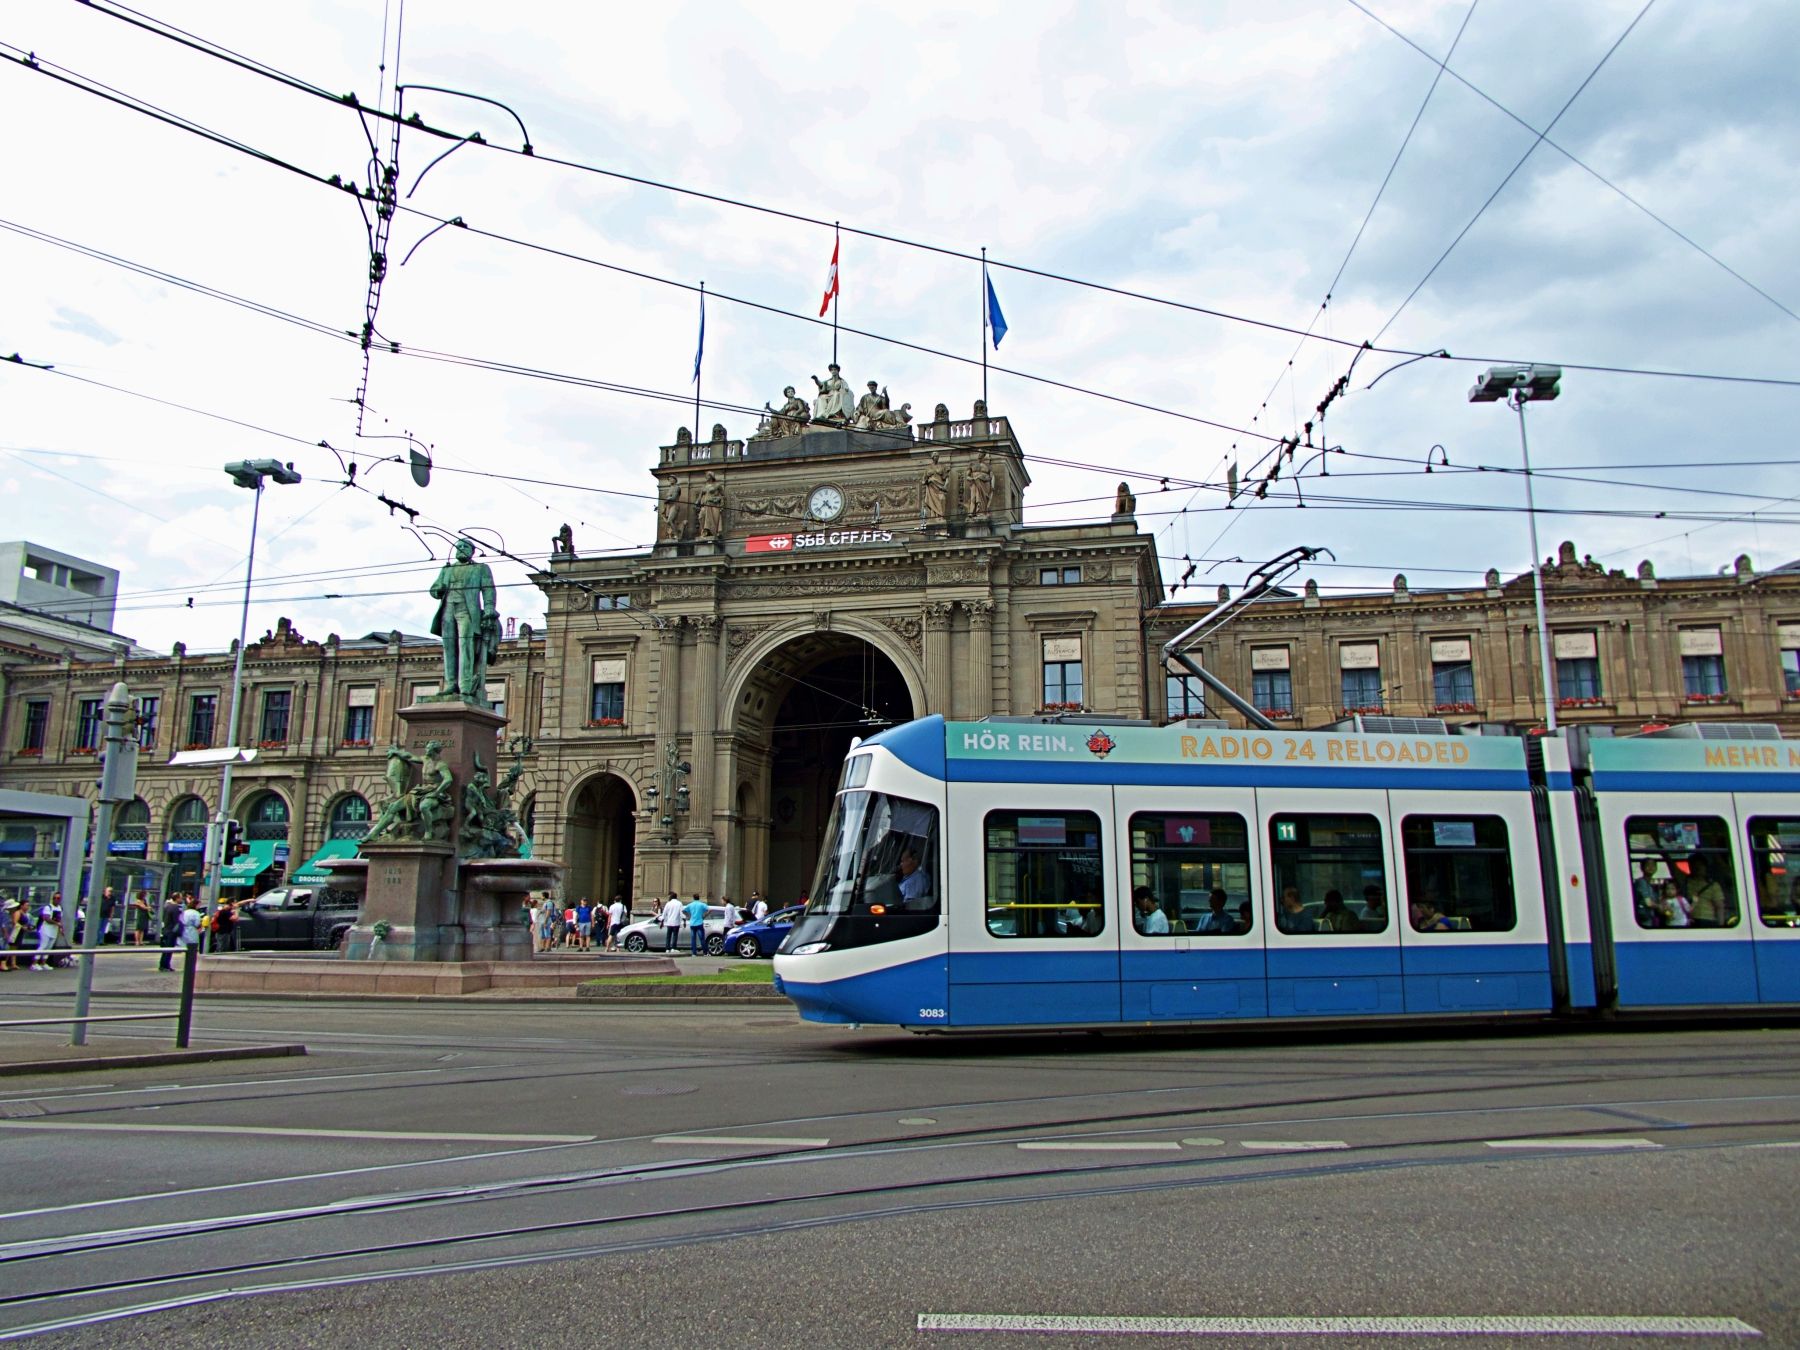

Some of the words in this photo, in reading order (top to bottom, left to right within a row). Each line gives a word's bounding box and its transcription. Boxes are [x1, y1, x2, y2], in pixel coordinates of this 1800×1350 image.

[795, 534, 826, 547] SBB
[963, 730, 1010, 750] HÖR
[1018, 735, 1074, 752] REIN.
[1181, 735, 1273, 759] RADIO
[1284, 738, 1316, 760] 24
[1327, 739, 1470, 763] RELOADED
[1704, 745, 1778, 768] MEHR
[1280, 824, 1295, 839] 11
[919, 1008, 945, 1018] 3083
